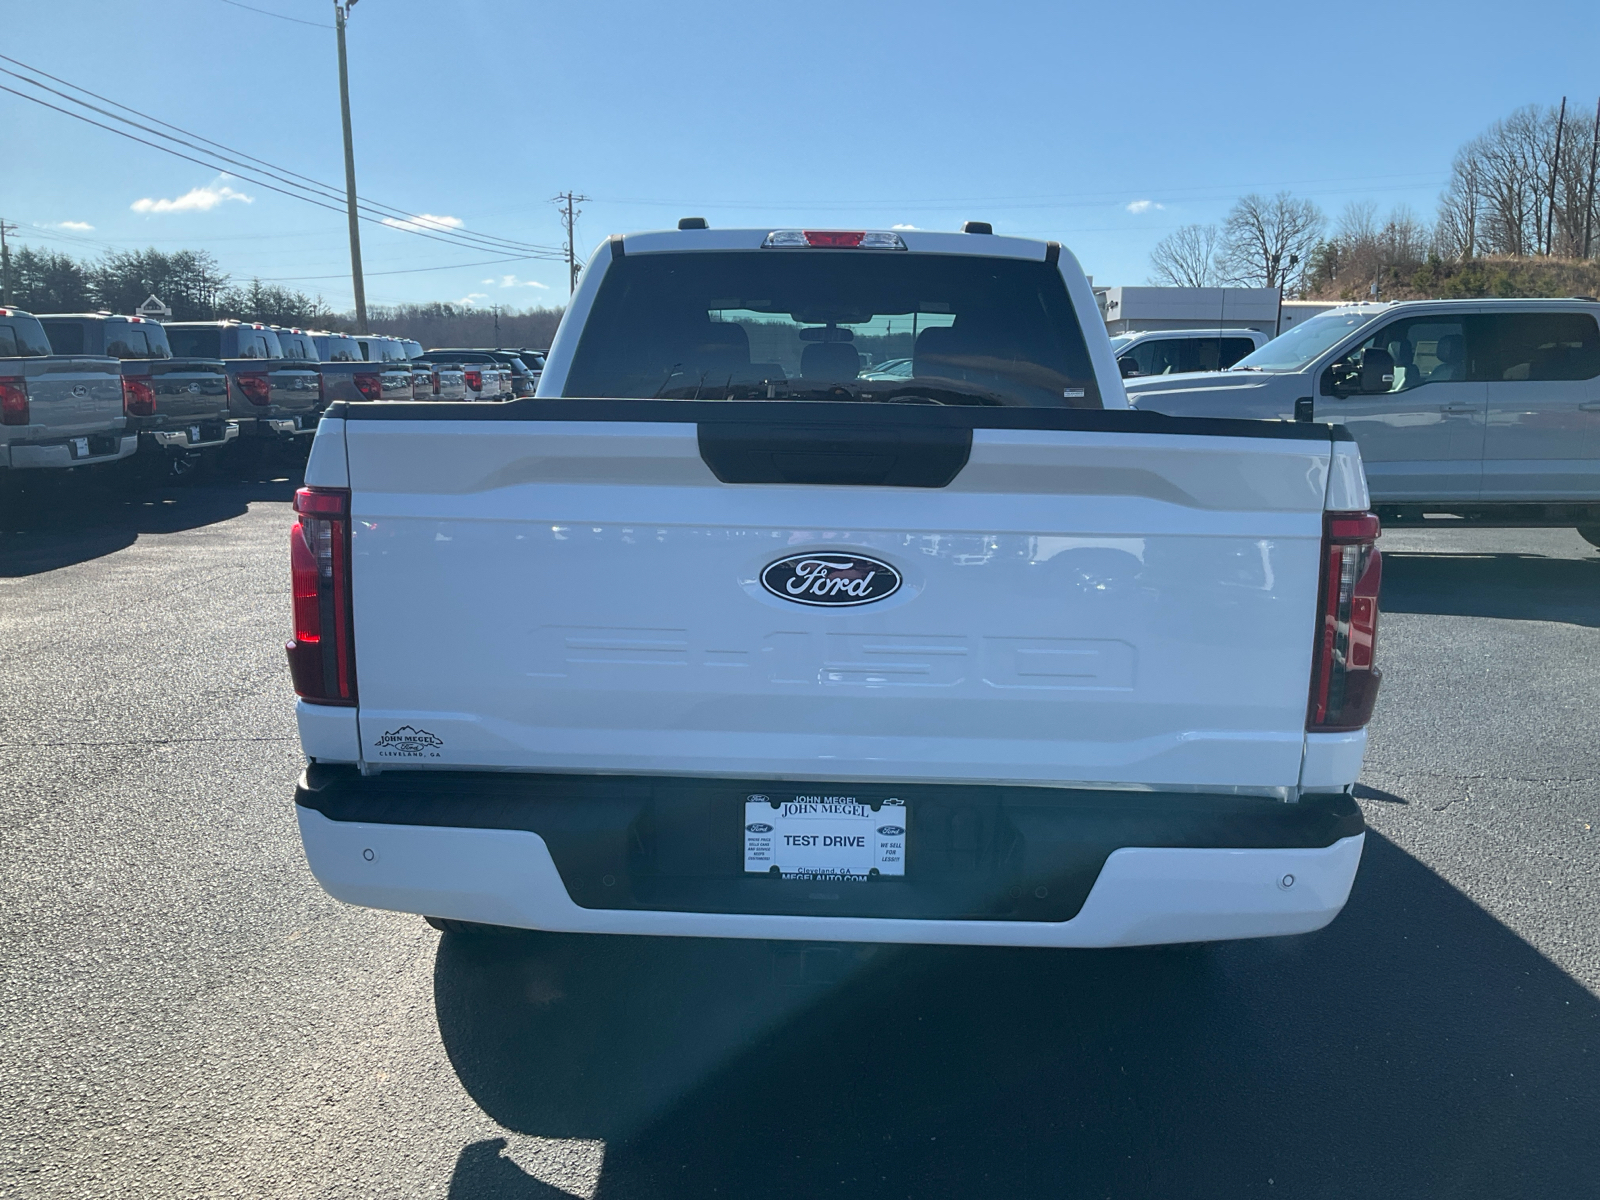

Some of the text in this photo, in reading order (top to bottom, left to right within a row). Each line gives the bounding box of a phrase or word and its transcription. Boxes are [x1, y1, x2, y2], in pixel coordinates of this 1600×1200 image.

[786, 554, 876, 597] Ford
[380, 735, 435, 745] JOHN MEGEL
[793, 796, 859, 805] JOHN MEGEL
[782, 804, 870, 818] JOHN MEGEL
[783, 835, 865, 847] TEST DRIVE
[797, 867, 838, 875] Cleveland,
[781, 873, 868, 882] MEGELAUTOCOM
